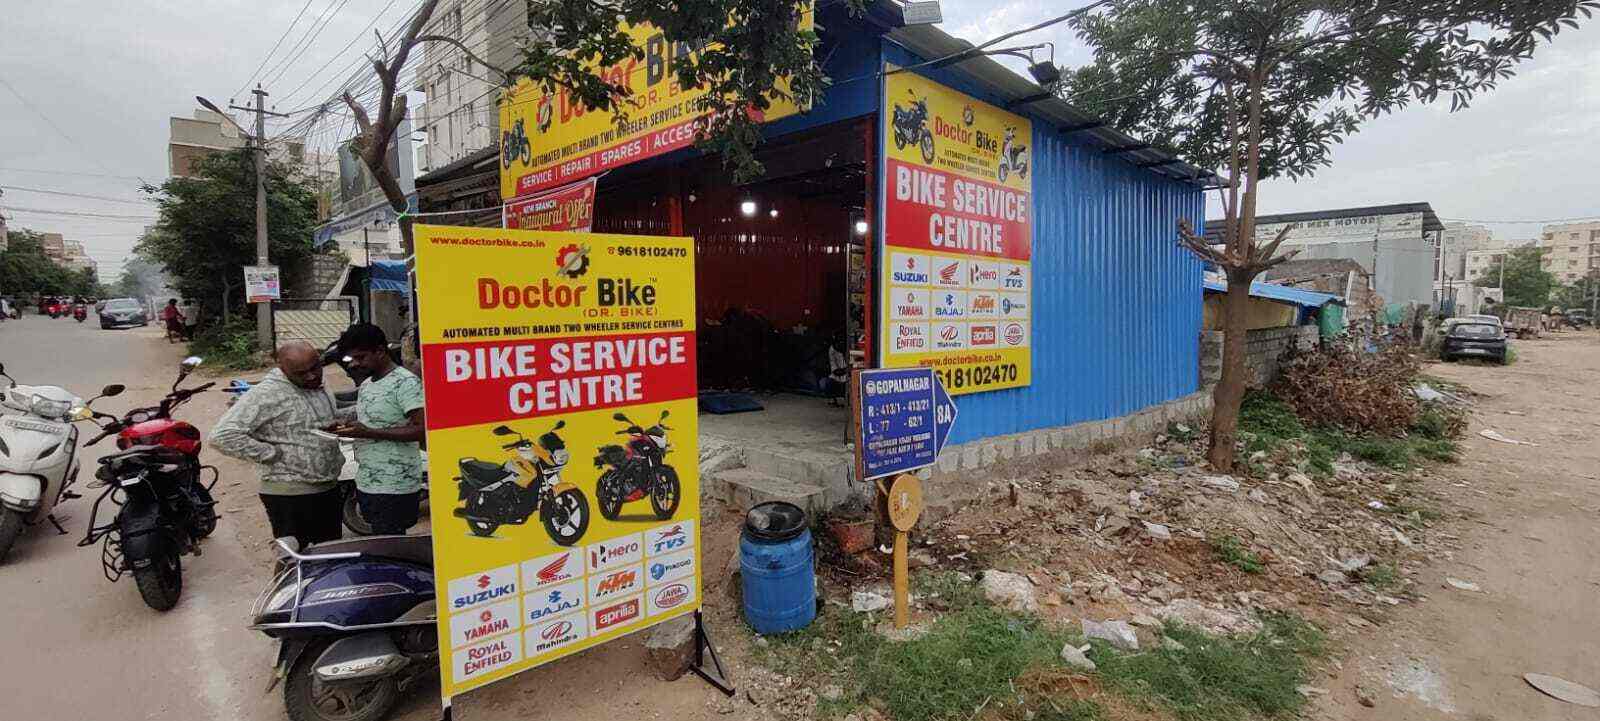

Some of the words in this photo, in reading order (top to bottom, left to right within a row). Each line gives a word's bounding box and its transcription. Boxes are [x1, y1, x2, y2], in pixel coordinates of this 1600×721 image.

[532, 150, 561, 169] AUTOMATED
[579, 135, 599, 152] BRAND
[601, 130, 614, 144] TWO
[616, 116, 648, 139] WHEELER
[650, 103, 682, 127] SERVICE
[935, 115, 973, 146] Doctor
[976, 130, 998, 154] Bike
[522, 169, 552, 189] SERVICE
[561, 157, 592, 177] REPAIR
[601, 140, 642, 166] SPARES
[896, 166, 946, 209] BIKE
[953, 178, 1027, 223] SERVICE
[430, 236, 546, 249] www.doctorbike.co.in
[929, 212, 1003, 254] CENTRE
[617, 246, 687, 258] 9618102470
[893, 272, 928, 283] SUZUKI
[1005, 278, 1024, 288] TVS
[478, 277, 587, 310] Doctor
[597, 277, 656, 307] Bike
[620, 306, 658, 317] BIKE)
[897, 305, 924, 317] YAMAHA
[935, 307, 964, 316] BAJAJ
[443, 327, 500, 339] AUTOMATED
[503, 326, 530, 337] MULTI
[532, 324, 561, 335] BRAND
[564, 323, 581, 333] TWO
[584, 321, 619, 332] WHEELER
[622, 320, 651, 330] SERVICE
[653, 319, 683, 329] CENTRES
[899, 324, 922, 337] ROYAL
[445, 344, 536, 383] BIKE
[550, 336, 686, 375] SERVICE
[509, 372, 643, 415] CENTRE
[876, 377, 930, 395] GOPALNAGAR
[937, 404, 952, 425] 8A
[608, 542, 639, 558] Hero
[655, 536, 687, 553] TVS
[454, 583, 515, 608] SUZUKI
[530, 598, 580, 620] BAJAJ
[599, 604, 637, 625] aprilia
[464, 618, 510, 641] YAMAHA
[468, 640, 508, 661] ROYAL
[464, 650, 513, 676] ENFIELD
